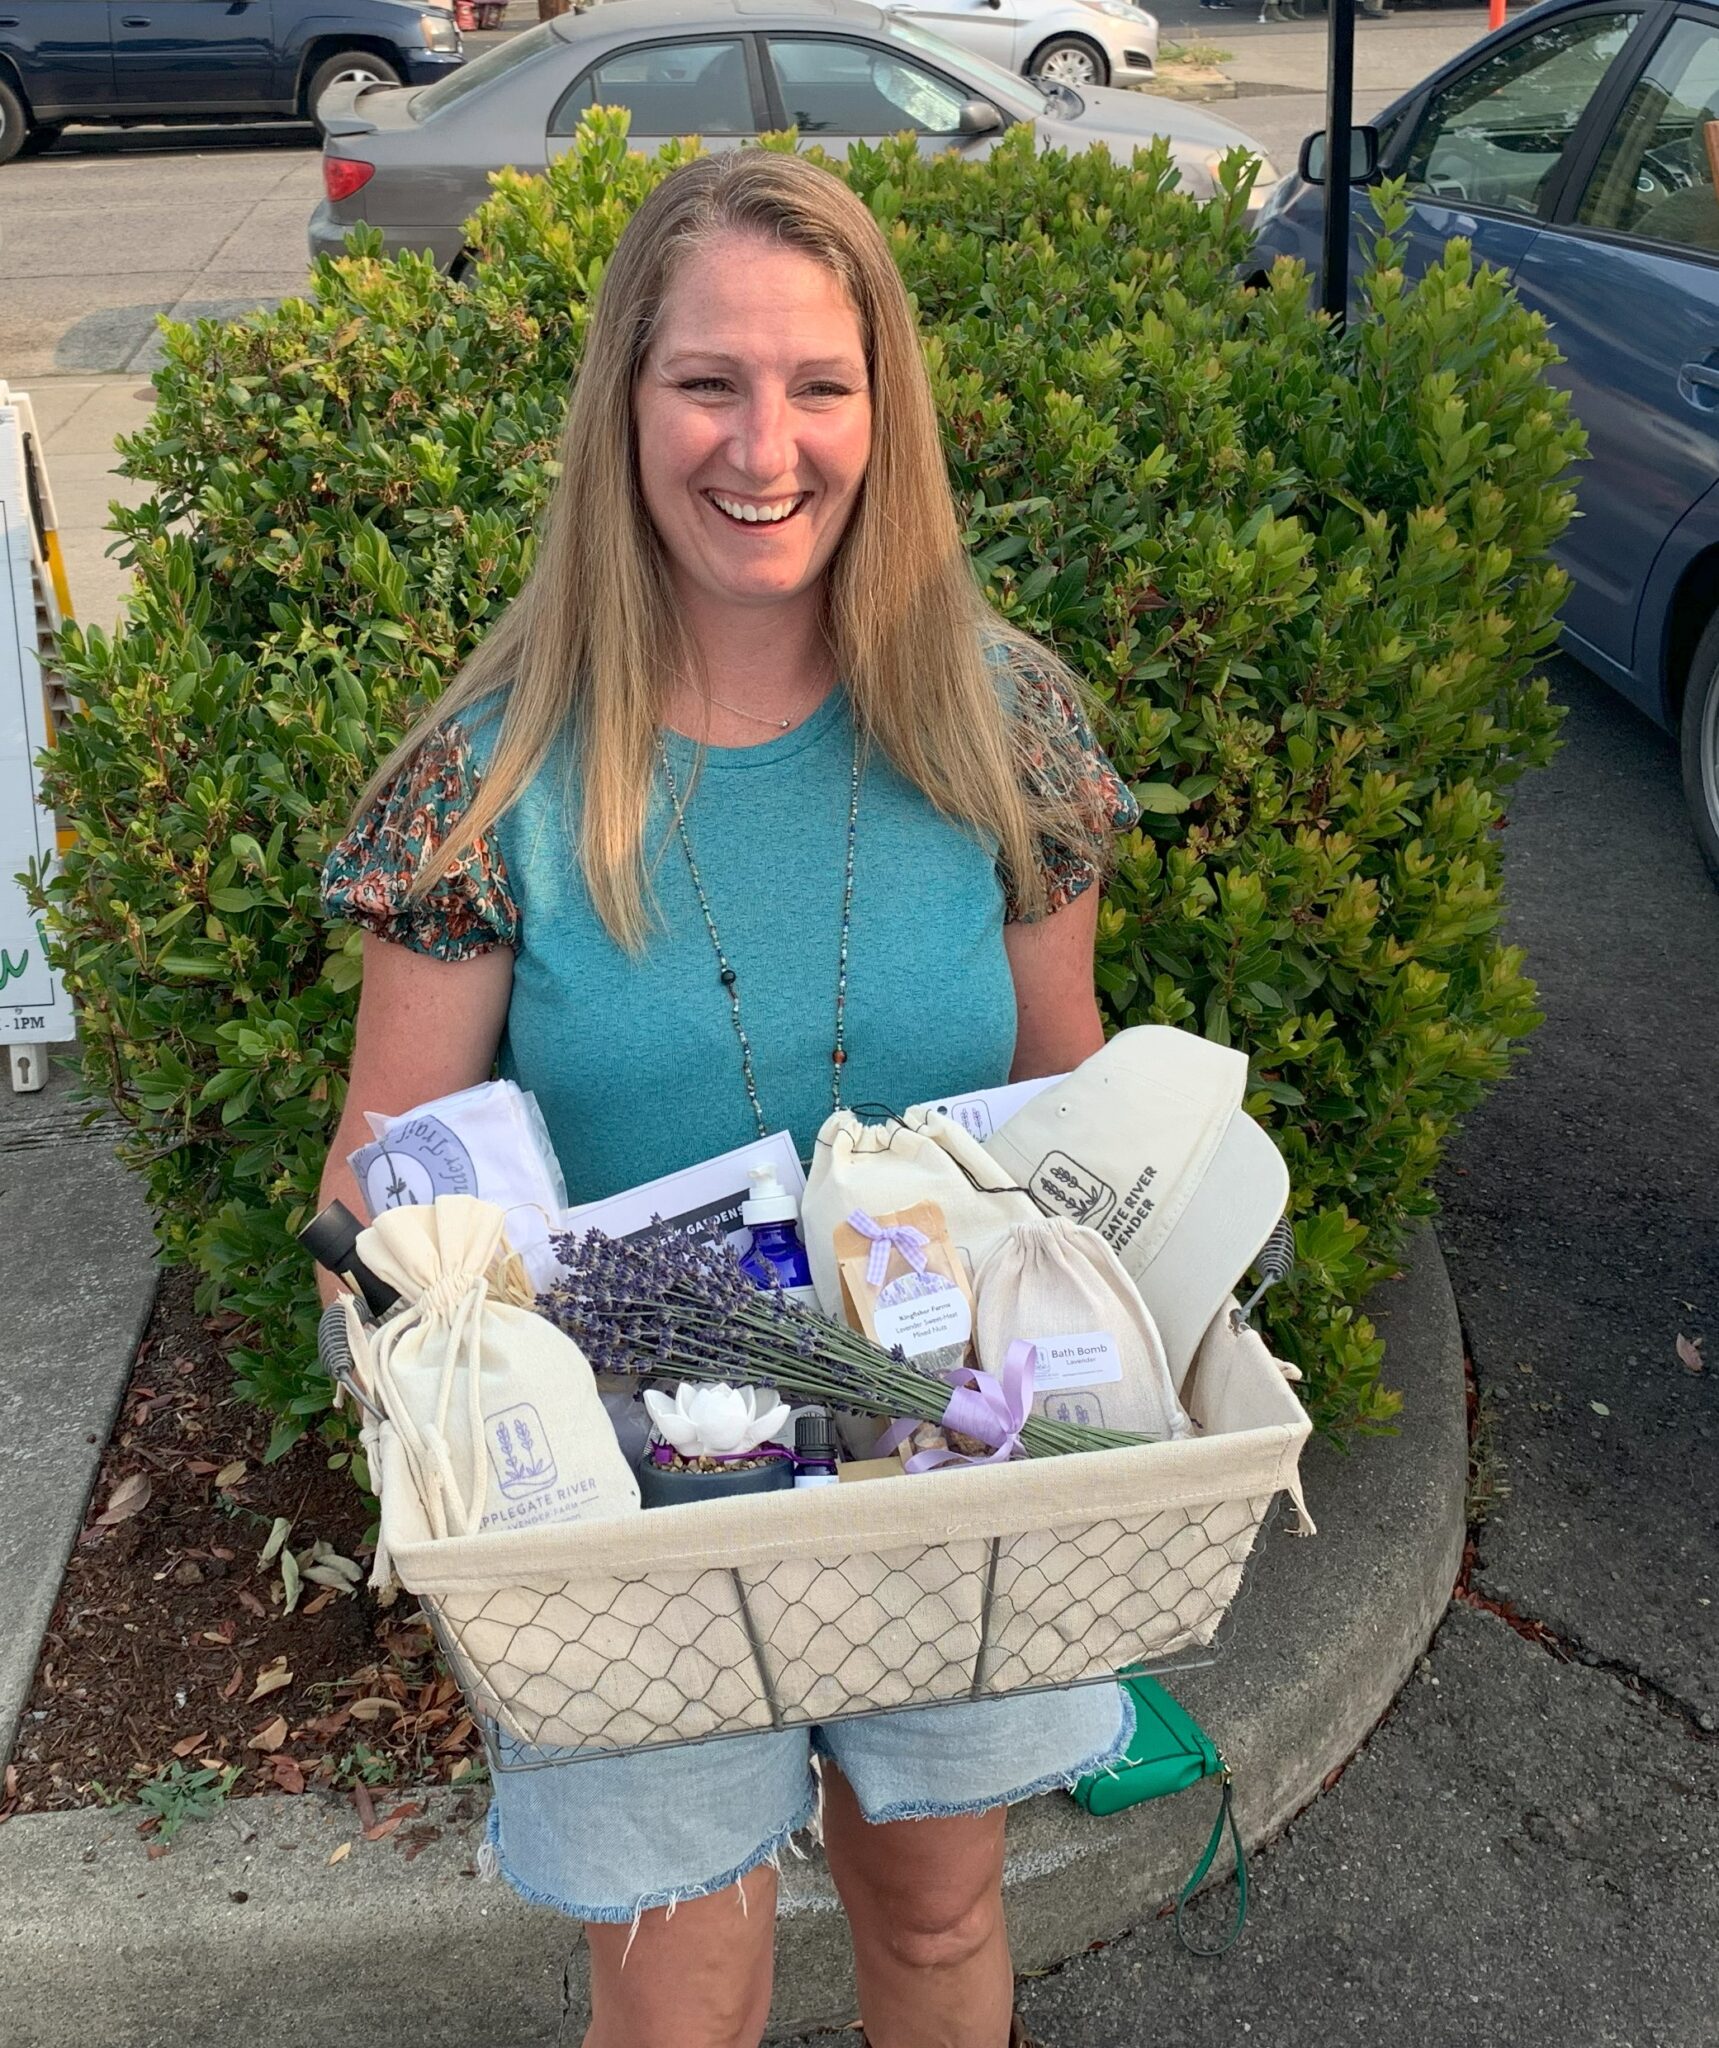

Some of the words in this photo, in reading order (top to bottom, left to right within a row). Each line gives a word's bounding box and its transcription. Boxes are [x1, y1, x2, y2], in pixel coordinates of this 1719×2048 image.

[14, 1016, 45, 1030] 1PM
[395, 1119, 448, 1156] Trail
[438, 1156, 469, 1195] nder
[1101, 1207, 1129, 1241] GATE
[1123, 1165, 1157, 1209] RIVER
[686, 1204, 743, 1235] GADENS
[1114, 1197, 1155, 1257] VENDER
[895, 1321, 922, 1334] Lavender
[1051, 1347, 1075, 1359] Bath
[1077, 1344, 1107, 1356] Bomb
[1066, 1357, 1096, 1366] Lavender
[557, 1478, 597, 1501] RIVER
[507, 1510, 551, 1530] VENDER
[553, 1502, 578, 1516] FARM
